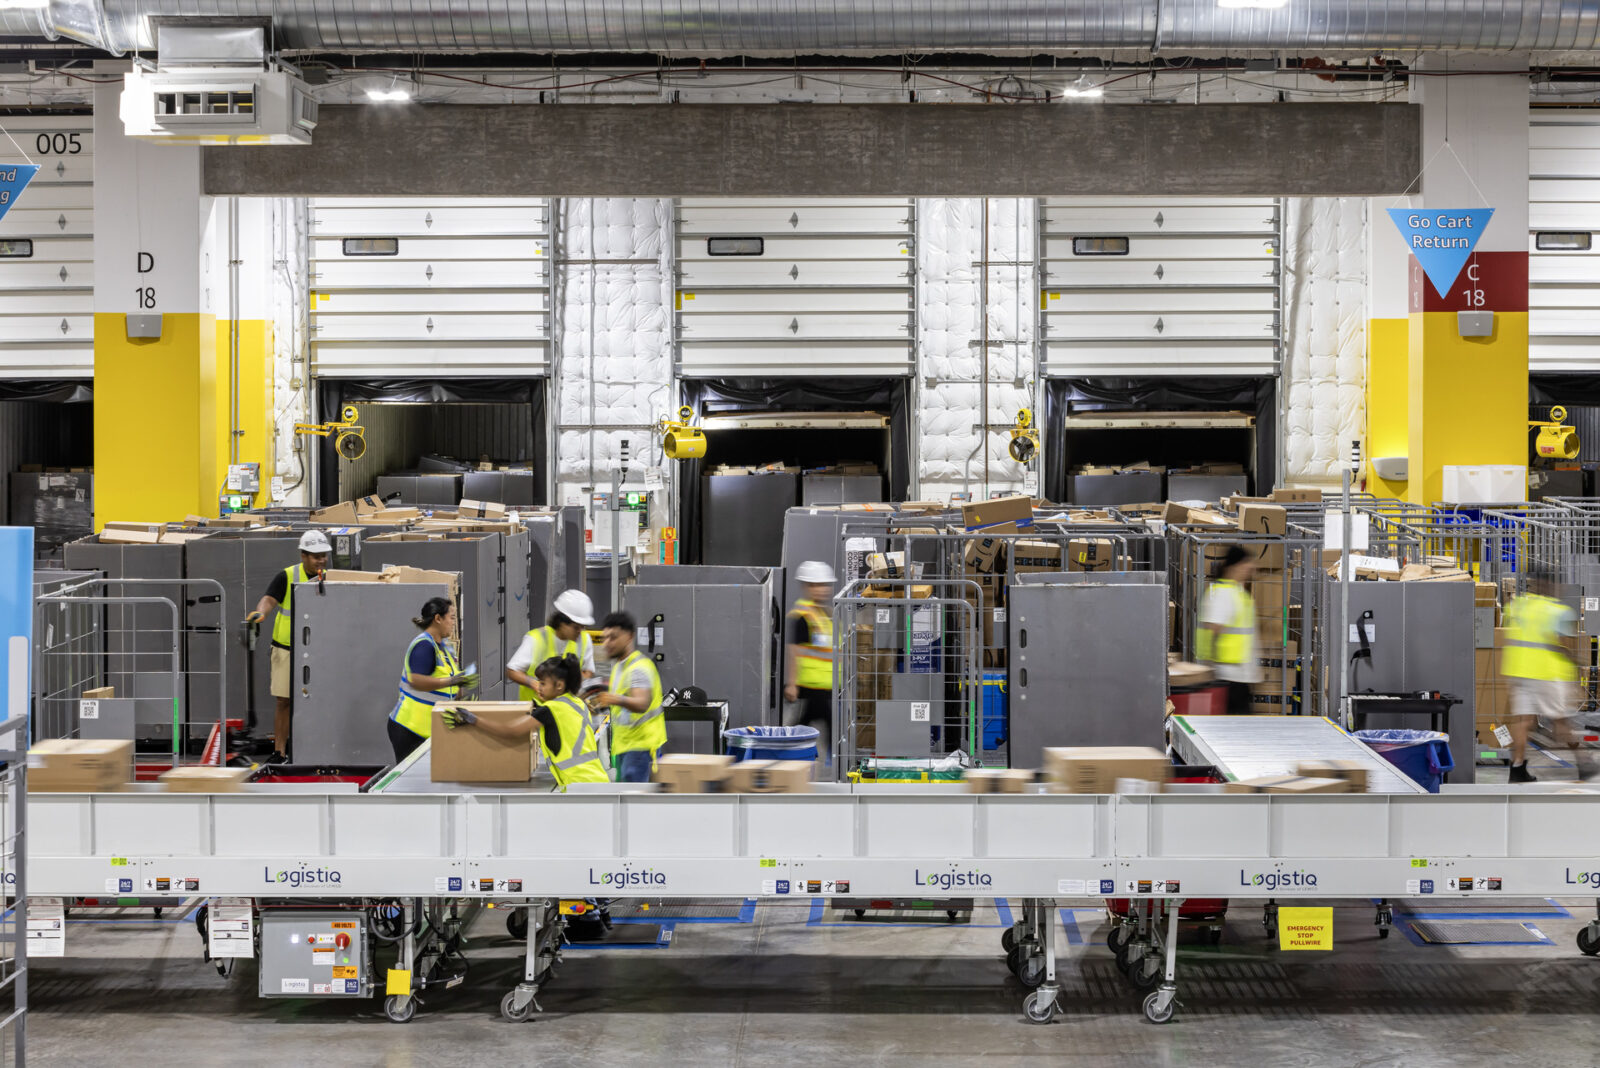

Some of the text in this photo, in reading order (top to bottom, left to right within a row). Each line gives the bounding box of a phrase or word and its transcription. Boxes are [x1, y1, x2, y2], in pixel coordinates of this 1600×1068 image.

[36, 132, 82, 155] 005
[1408, 215, 1473, 228] Go Cart
[1412, 235, 1470, 248] Return
[137, 252, 154, 273] D
[1467, 264, 1480, 281] C
[135, 287, 156, 309] 18
[1463, 289, 1486, 306] 18
